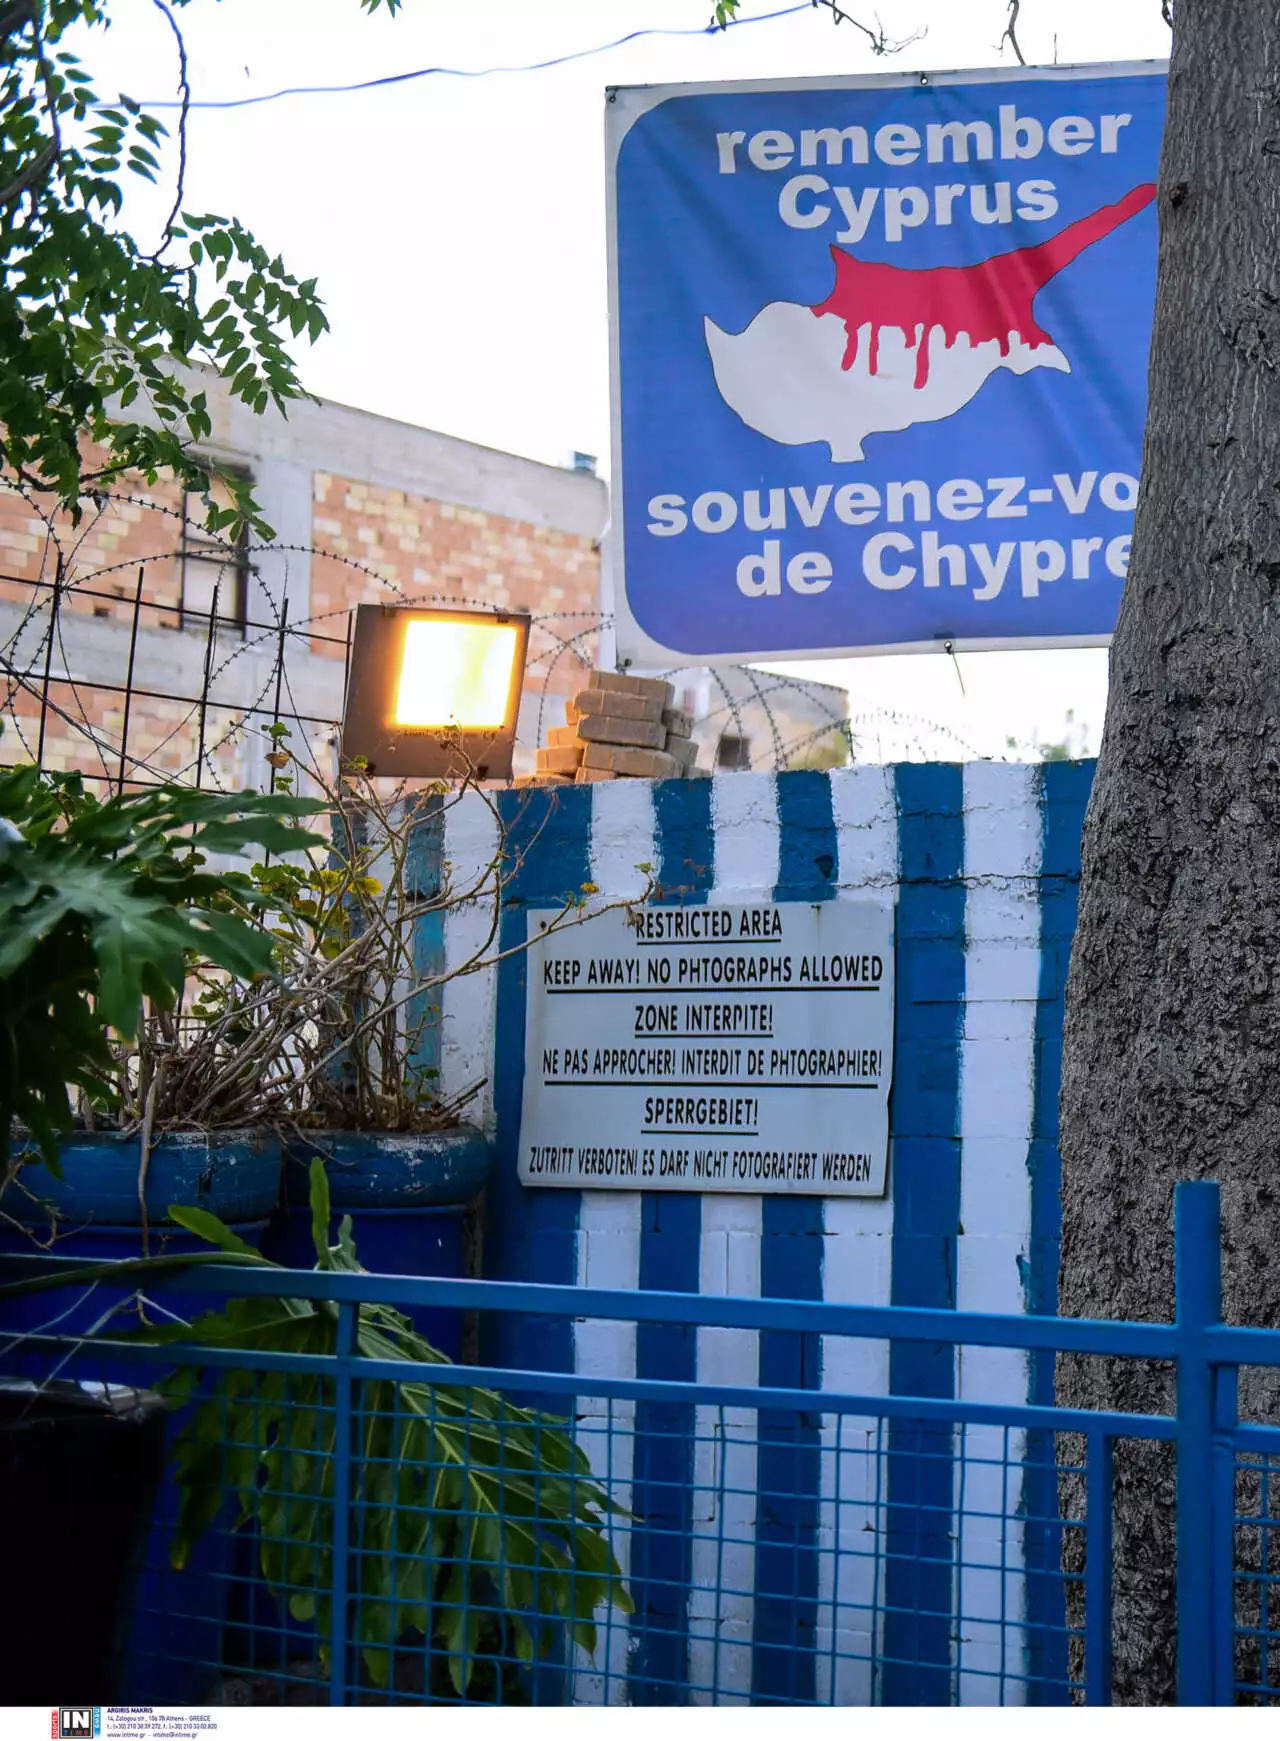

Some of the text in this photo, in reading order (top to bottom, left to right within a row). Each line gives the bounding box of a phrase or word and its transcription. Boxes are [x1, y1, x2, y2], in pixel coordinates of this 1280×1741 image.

[717, 105, 1132, 173] remember
[778, 174, 1058, 243] Cyprus
[736, 540, 833, 597] de
[636, 909, 782, 938] RESTRICTED AREA
[543, 955, 883, 985] KEEP AWAY! NO PHTOGRAPHS ALLOWED
[635, 1005, 678, 1031] ZONE
[543, 1049, 882, 1077] NE PAS APPROCHER! INTERDIT DE PHTOGRAPHIER!
[644, 1097, 758, 1126] SPERRGEBIET!
[529, 1147, 871, 1182] ZUTRITT VERBOTEN! ES DARF NICHT FOTOGRAFIERT WERDEN
